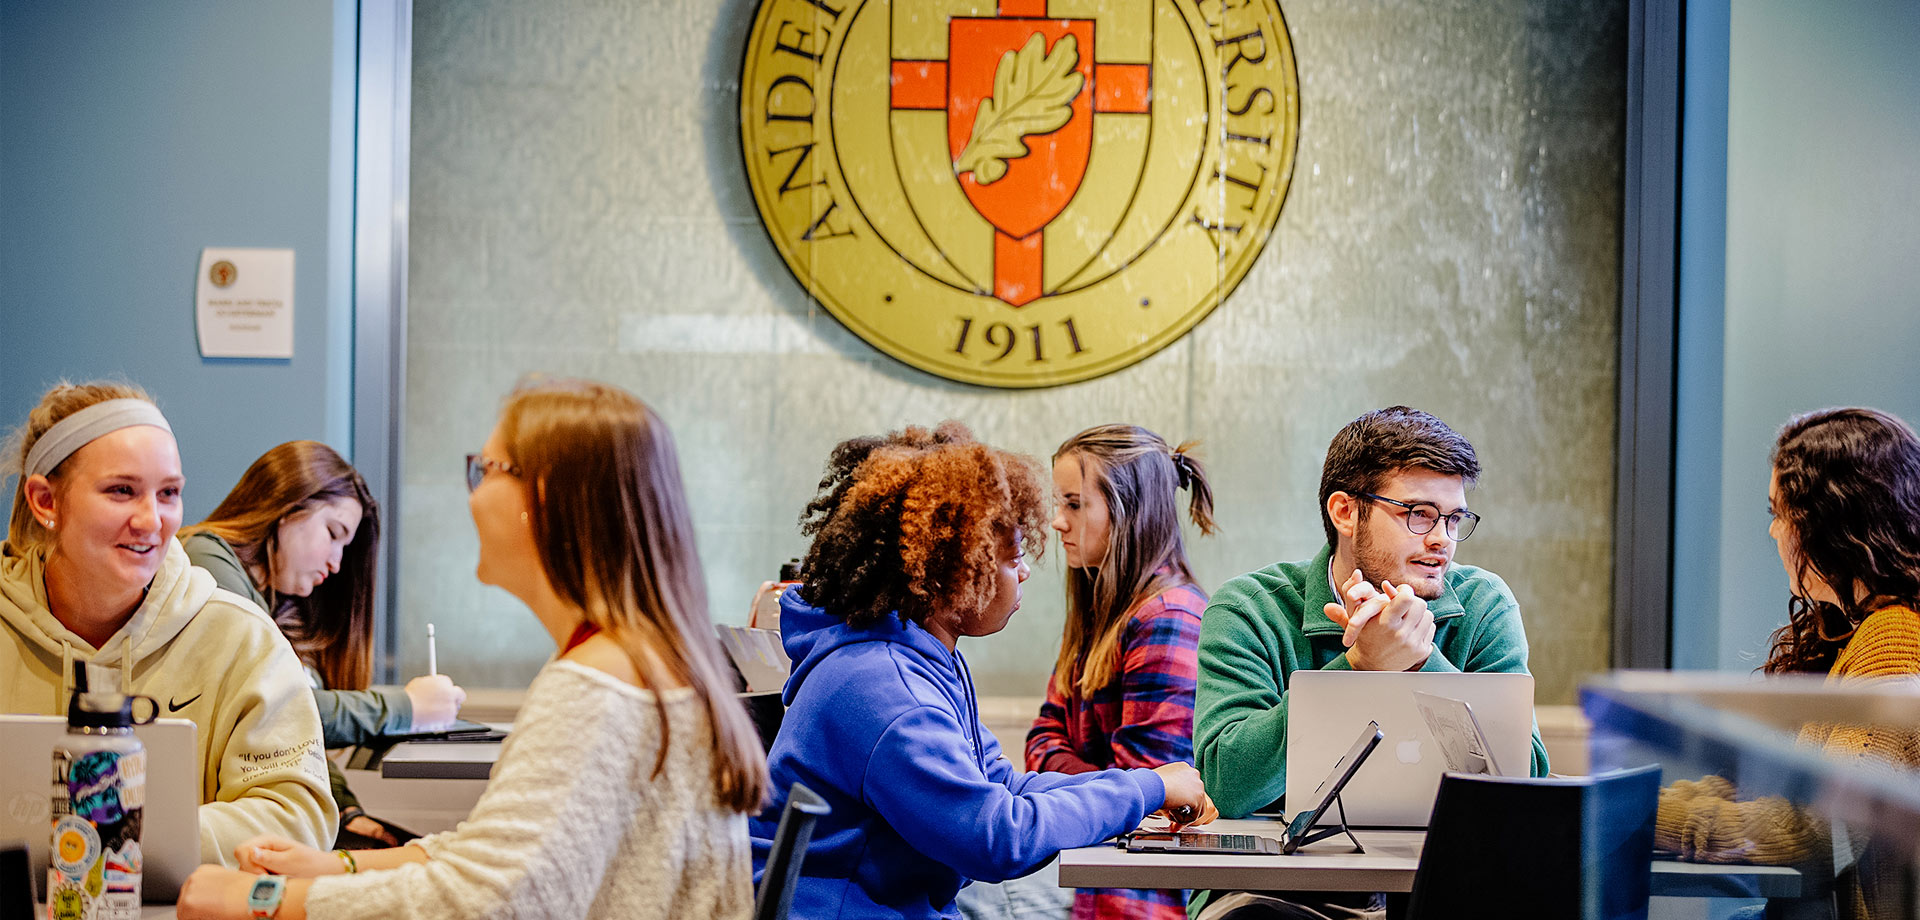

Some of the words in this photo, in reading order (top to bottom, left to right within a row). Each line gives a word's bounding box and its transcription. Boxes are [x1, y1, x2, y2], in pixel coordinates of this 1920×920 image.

[947, 316, 1091, 366] 1911
[253, 752, 271, 763] you
[240, 765, 259, 773] You
[260, 762, 278, 771] will
